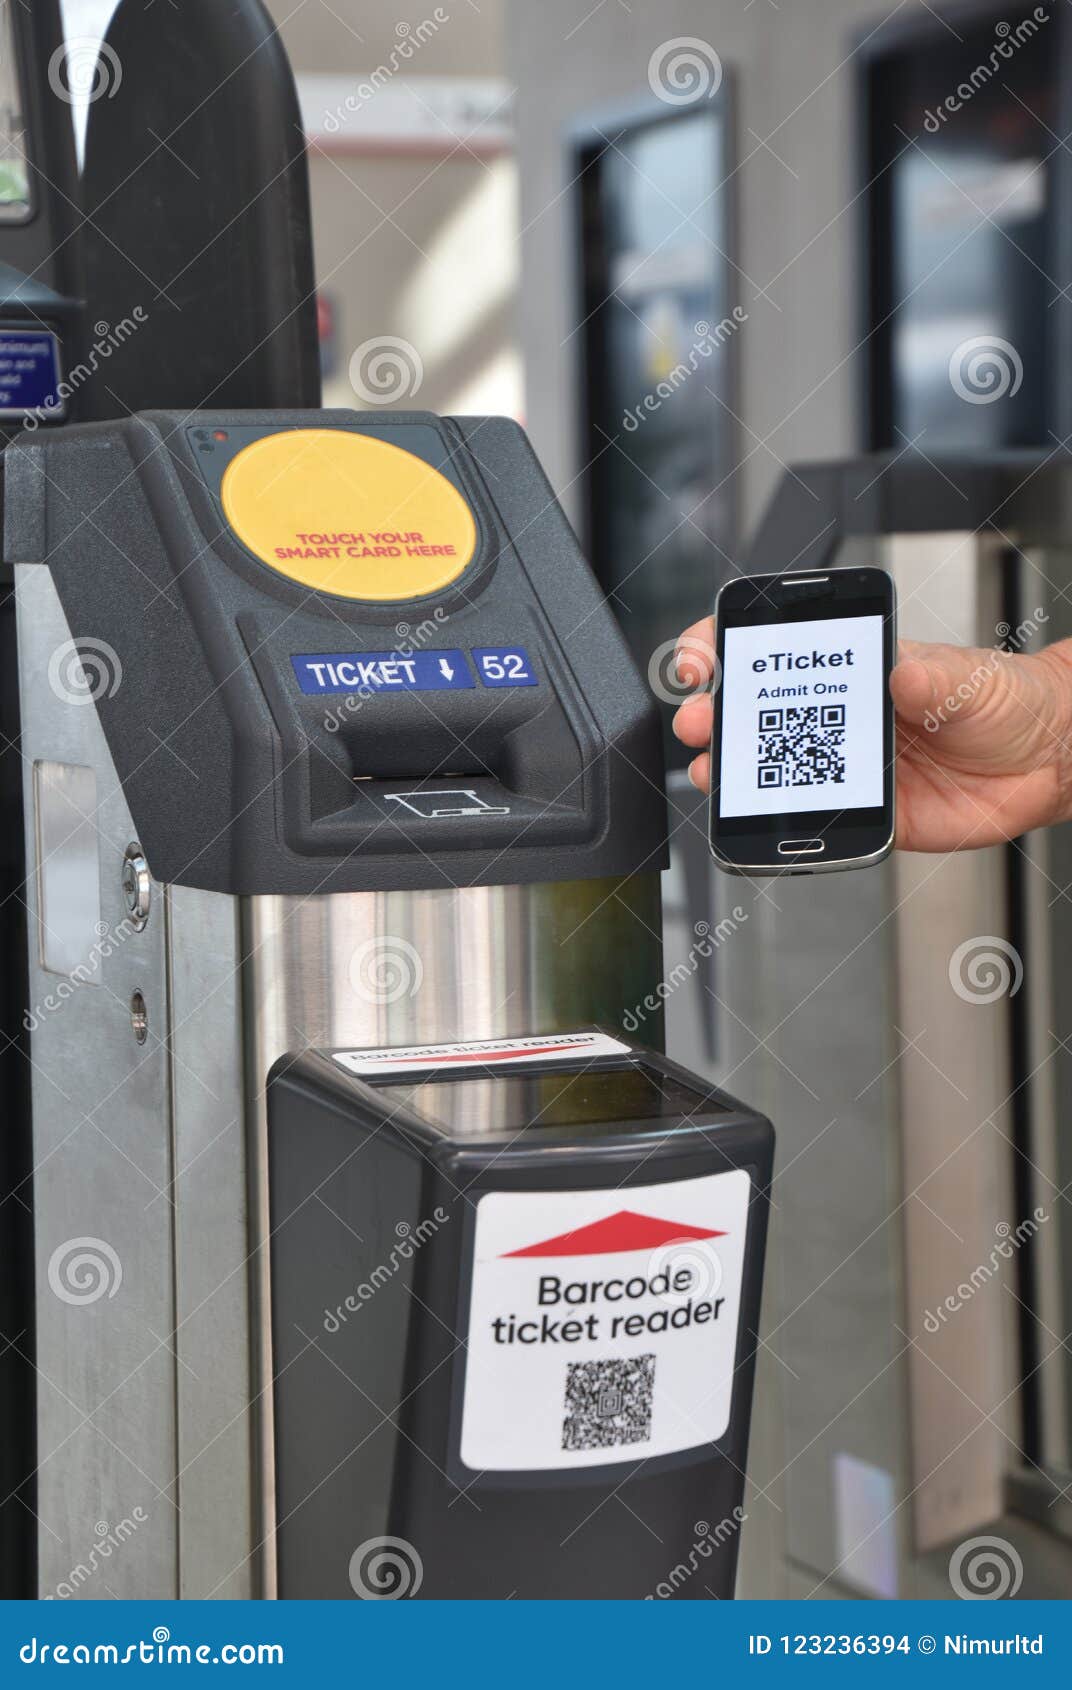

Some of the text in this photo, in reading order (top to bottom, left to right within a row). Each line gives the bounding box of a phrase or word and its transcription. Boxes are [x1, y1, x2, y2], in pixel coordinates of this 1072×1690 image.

[296, 532, 424, 545] TOUCH YOUR
[275, 545, 457, 558] SMART CARD HERE
[482, 654, 529, 680] 52
[752, 648, 854, 673] eTicket
[306, 660, 417, 687] TICKET
[757, 683, 848, 699] Admit One
[350, 1049, 448, 1060] Barcode
[523, 1036, 596, 1047] reader
[537, 1264, 693, 1306] Barcode
[491, 1298, 725, 1344] ticket reader
